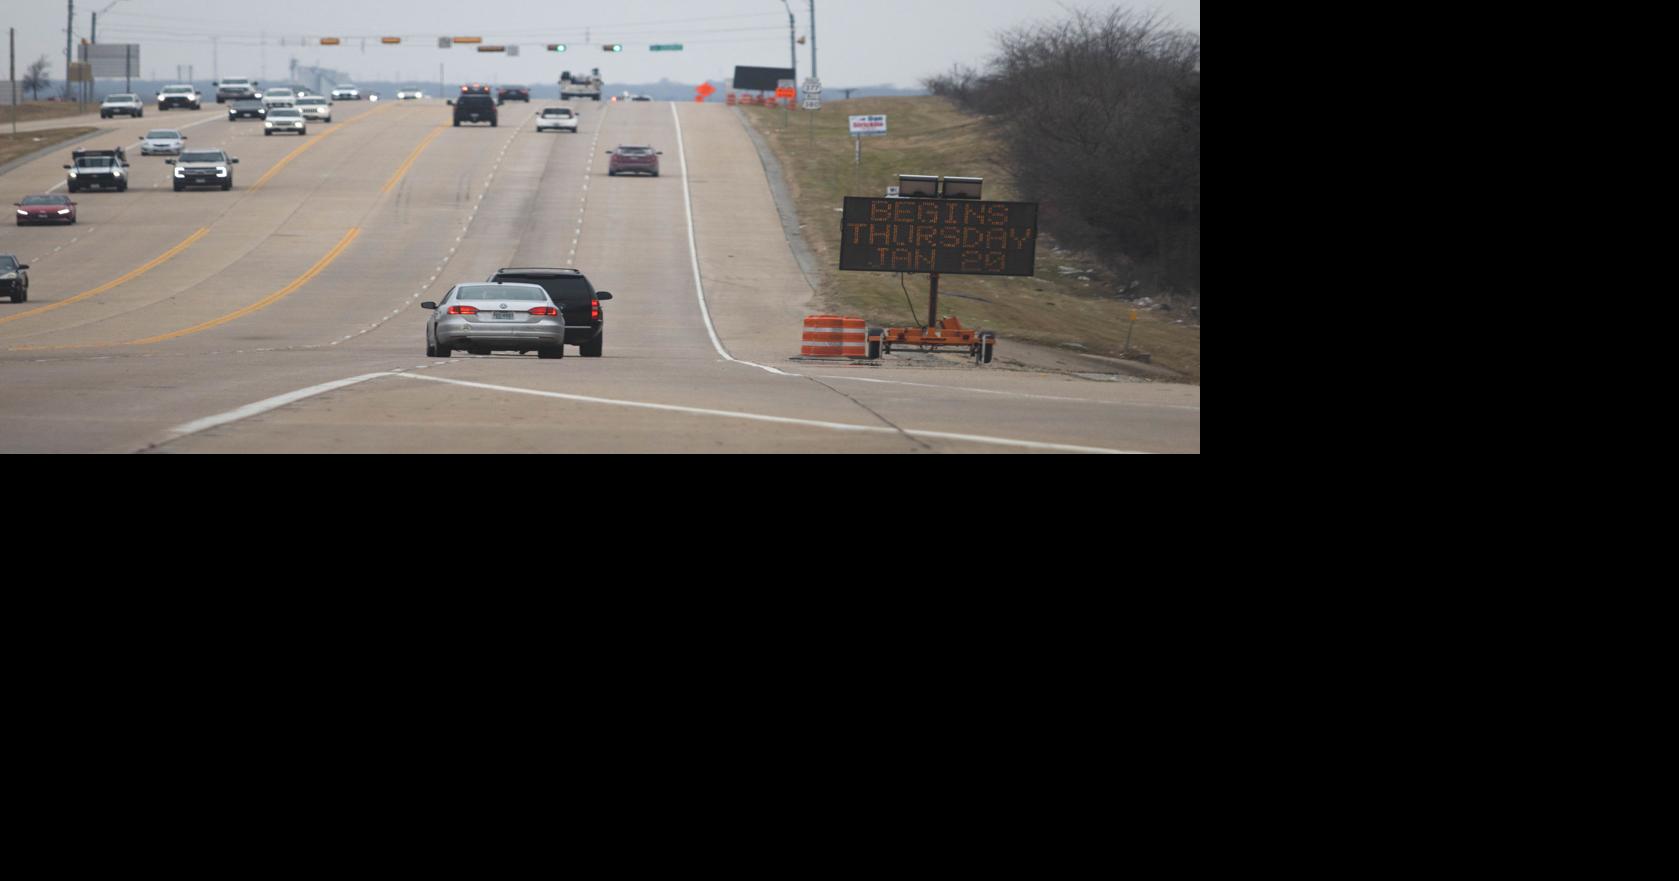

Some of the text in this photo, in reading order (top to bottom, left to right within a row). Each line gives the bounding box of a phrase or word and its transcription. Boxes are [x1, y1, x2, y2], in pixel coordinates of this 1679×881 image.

[870, 200, 1009, 225] BEGINS
[847, 223, 1031, 249] THURSDAY
[868, 247, 936, 272] JAN
